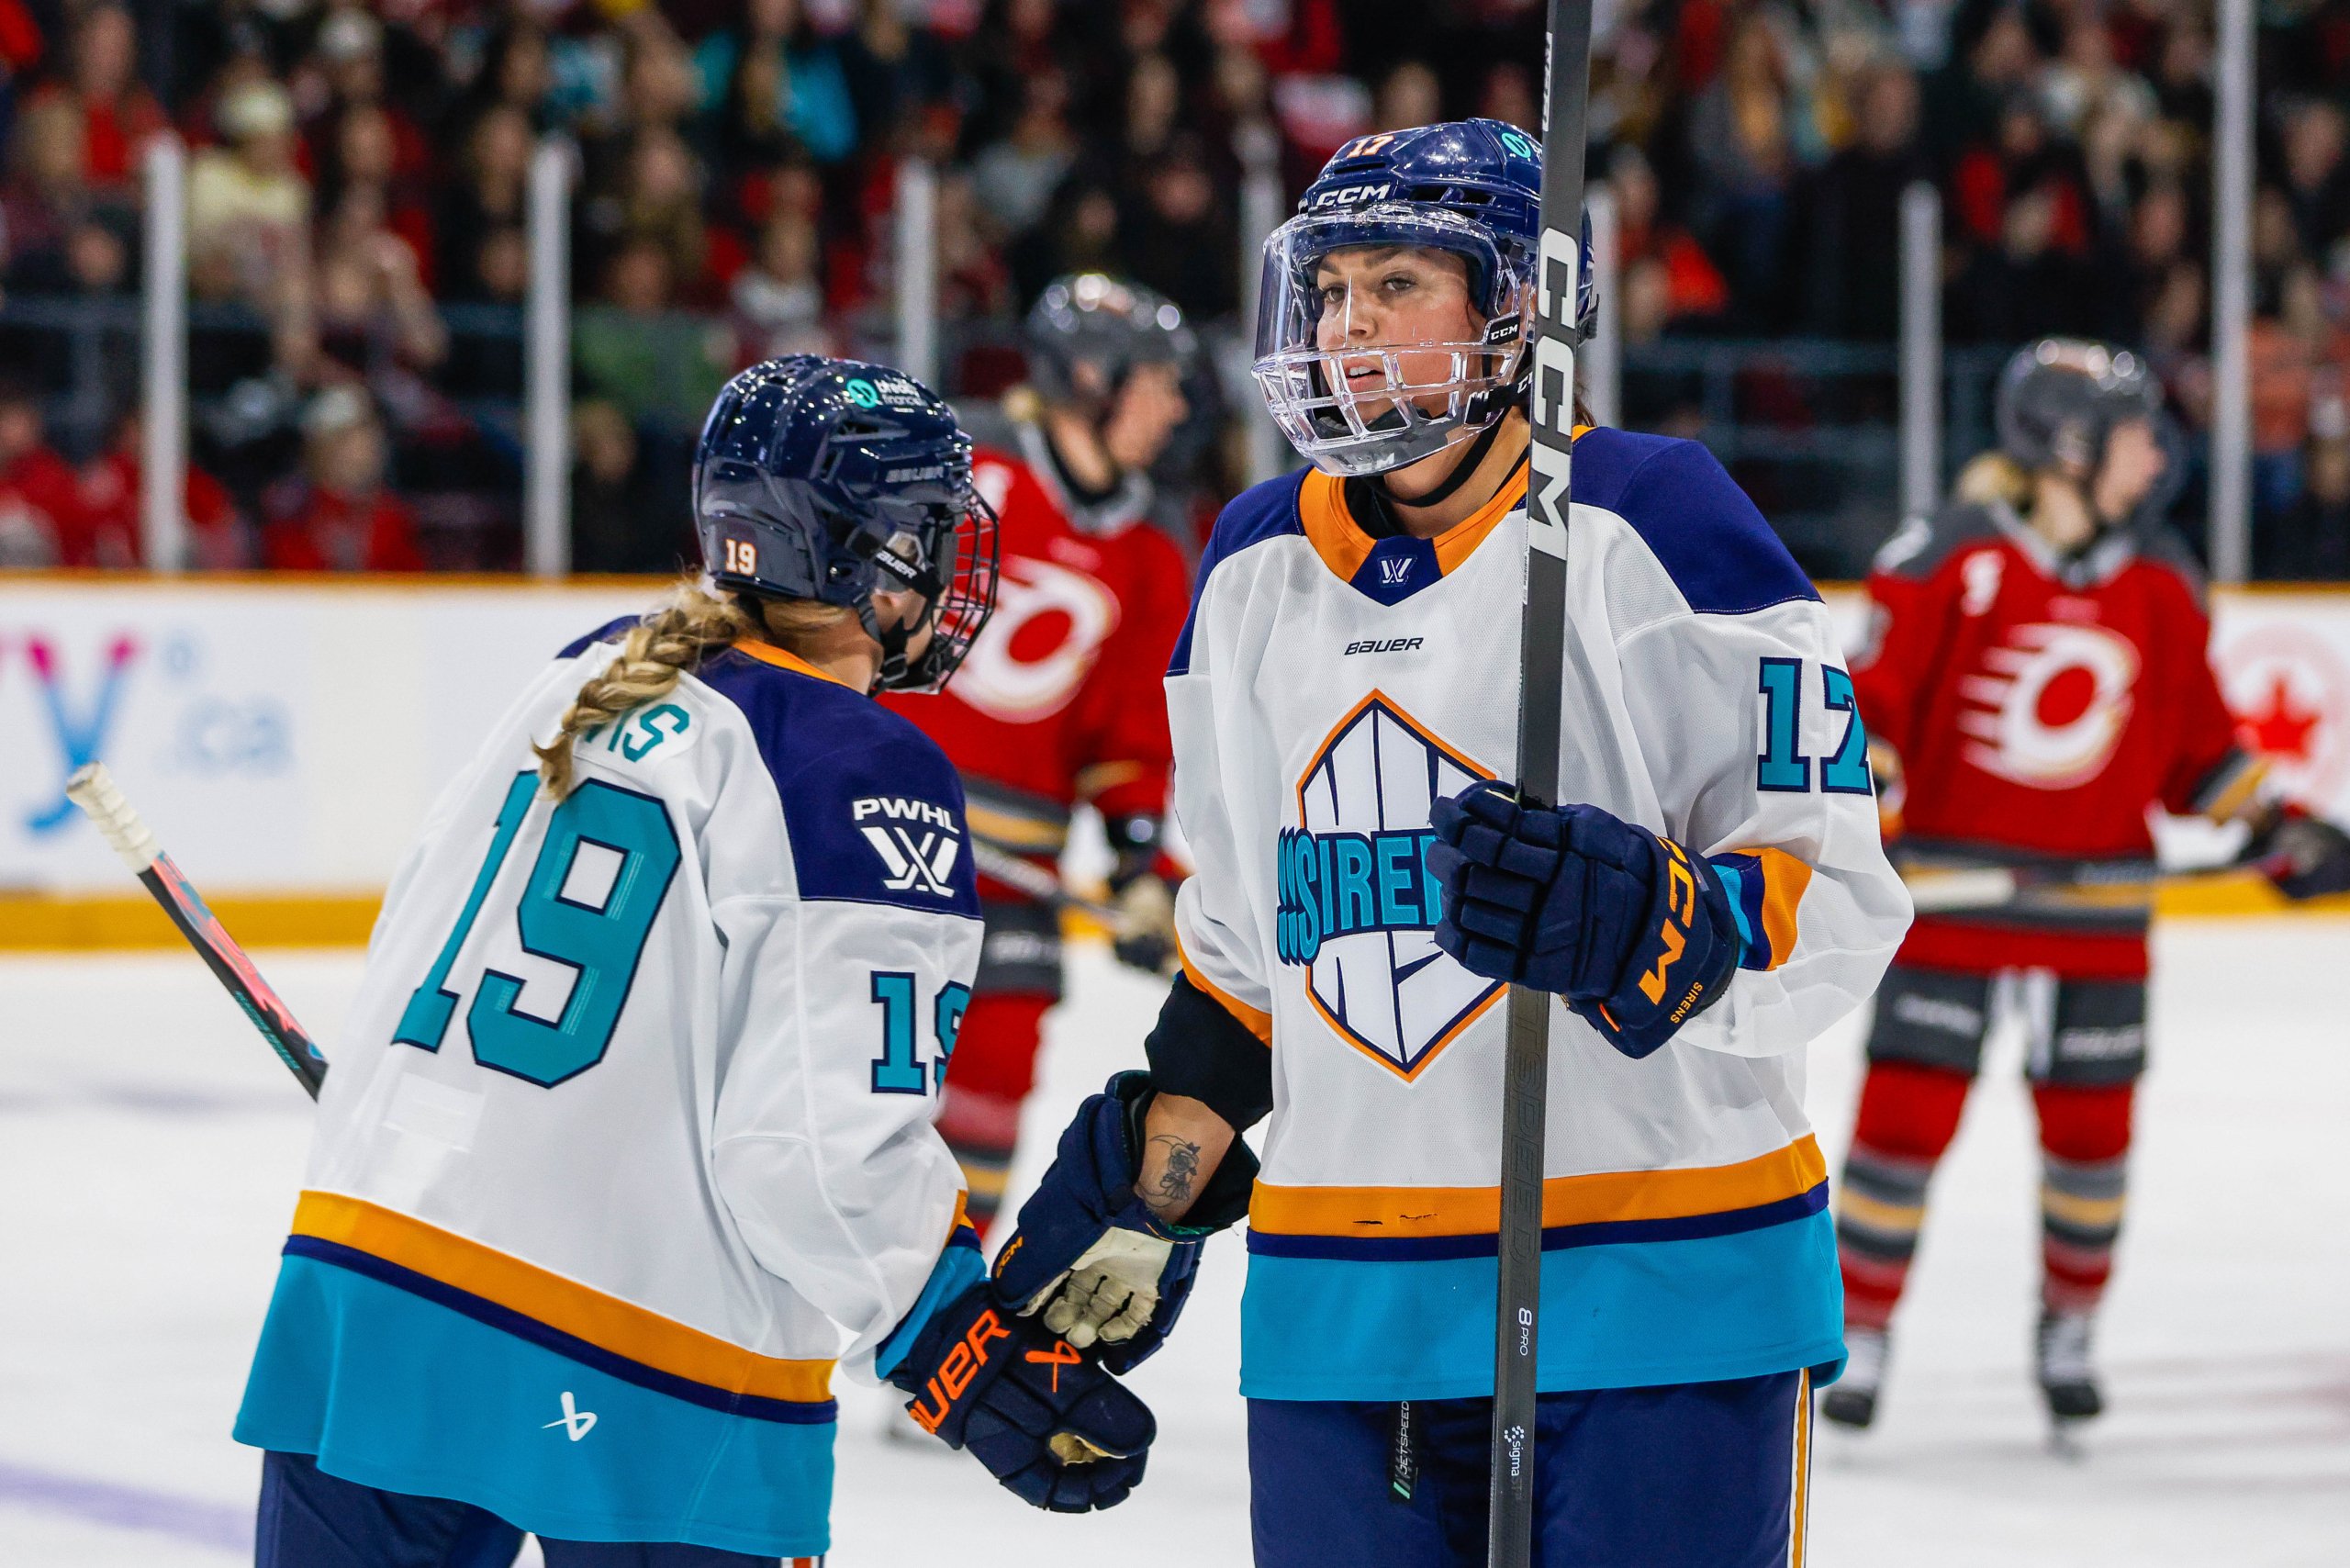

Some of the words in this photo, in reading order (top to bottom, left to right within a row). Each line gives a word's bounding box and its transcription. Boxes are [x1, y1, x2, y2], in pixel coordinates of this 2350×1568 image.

[1346, 134, 1394, 159] 17
[1316, 184, 1392, 207] CCM
[1490, 323, 1519, 341] CCM
[1528, 227, 1578, 561] CCM
[725, 538, 757, 577] 19
[876, 550, 918, 579] AUER
[1344, 637, 1424, 655] BAUER
[1757, 656, 1874, 797] 17
[852, 797, 961, 834] PWHL
[1277, 826, 1442, 964] SIRE
[390, 767, 683, 1090] 19
[1670, 980, 1704, 1025] SIRENS
[1519, 1327, 1529, 1356] PRO
[909, 1308, 1012, 1435] UER
[1399, 1400, 1410, 1475] JETSPEED
[1508, 1440, 1524, 1477] sigma
